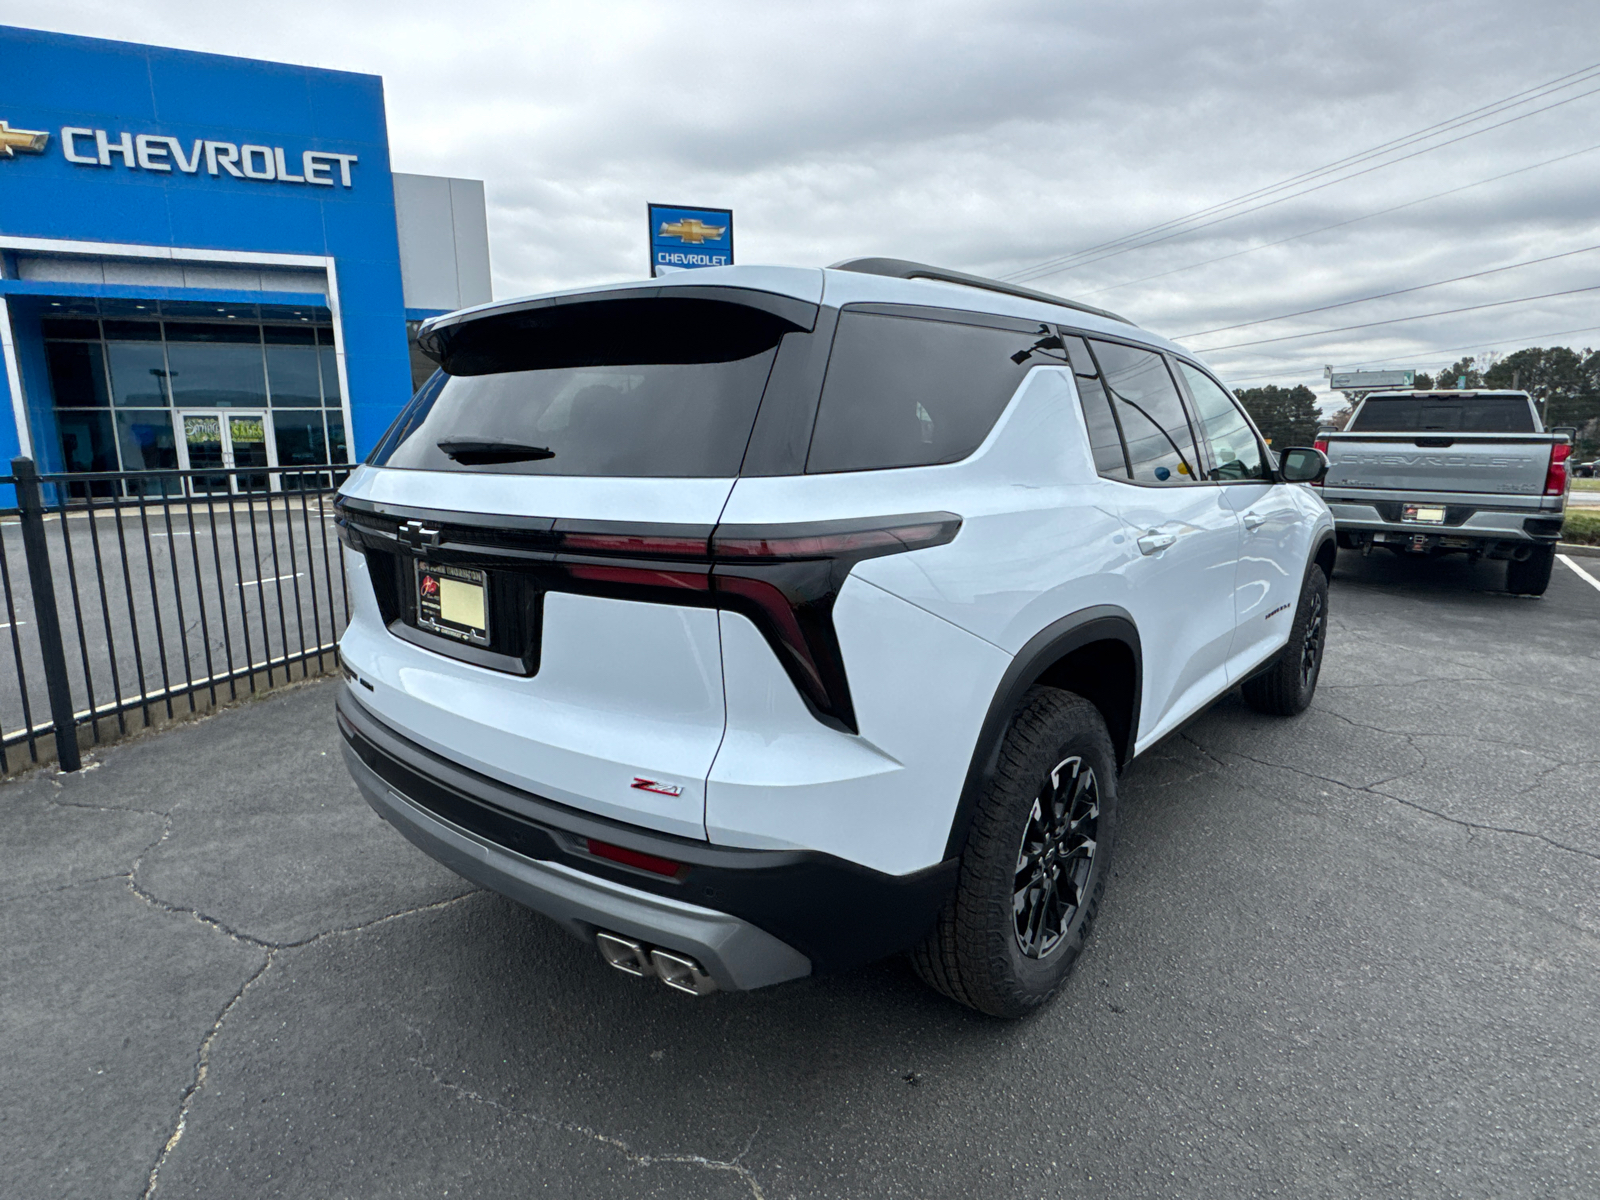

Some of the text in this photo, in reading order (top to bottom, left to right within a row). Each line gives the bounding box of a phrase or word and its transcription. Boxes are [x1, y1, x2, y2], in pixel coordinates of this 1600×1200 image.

[61, 126, 358, 187] CHEVROLET
[658, 253, 727, 266] CHEVROLET
[1340, 454, 1532, 469] CHEVROLET
